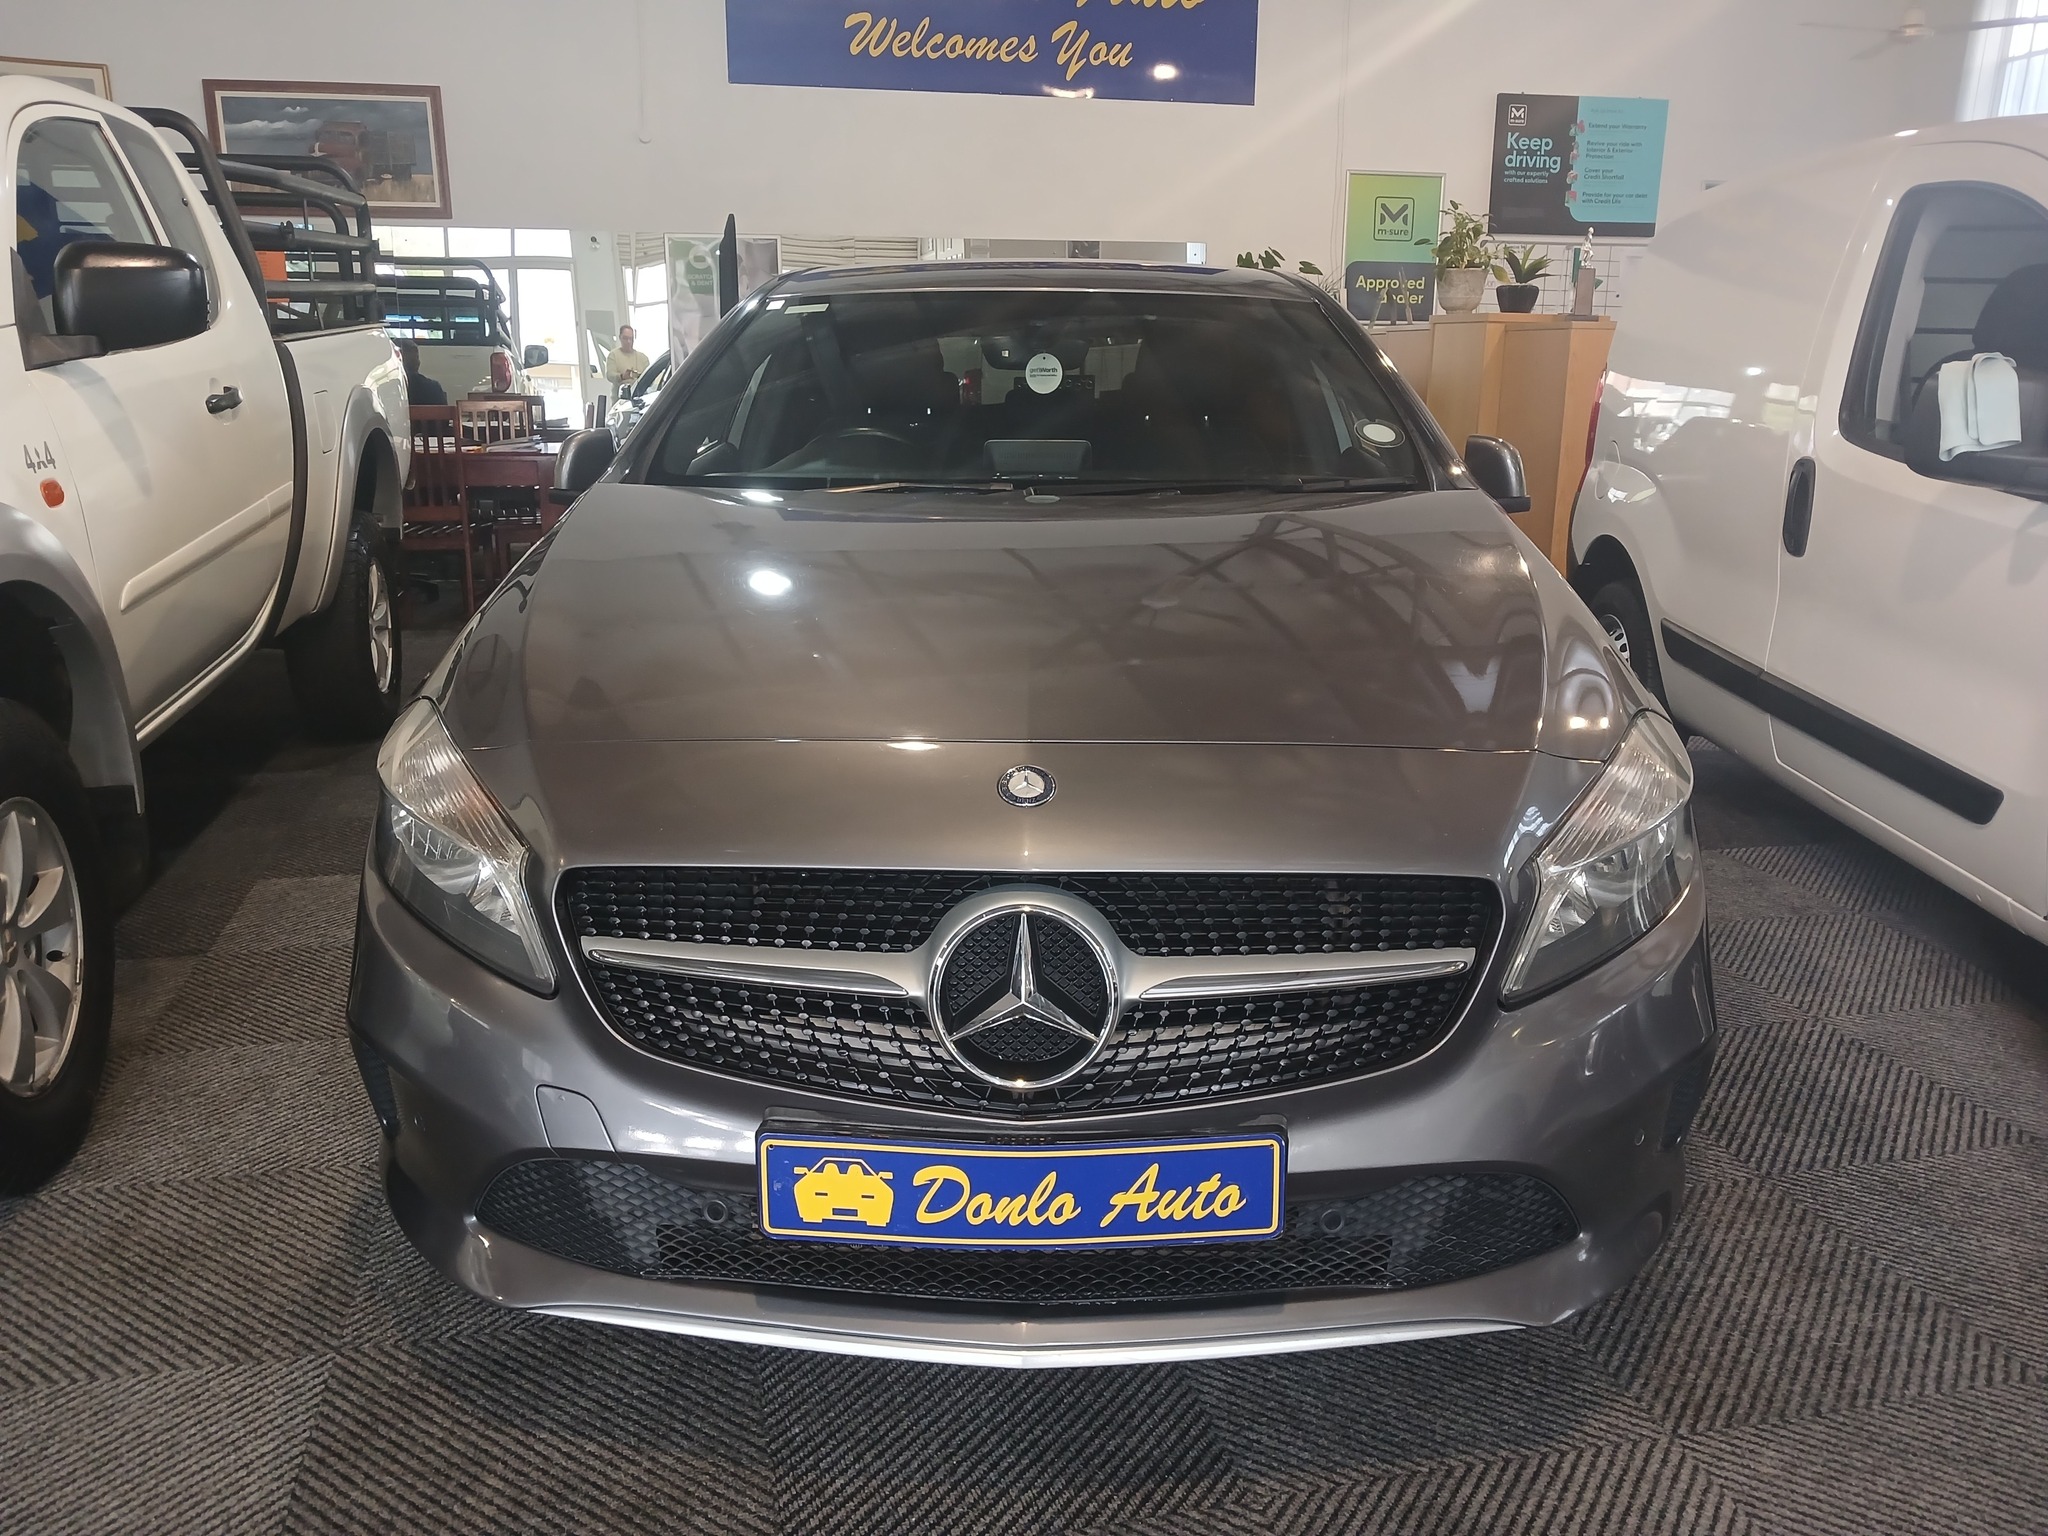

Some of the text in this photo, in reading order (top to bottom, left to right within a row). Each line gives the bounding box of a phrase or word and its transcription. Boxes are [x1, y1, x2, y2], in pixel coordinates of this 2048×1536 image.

[844, 12, 1133, 81] Welcomes You
[1507, 132, 1553, 155] Keep
[1504, 150, 1561, 173] driving
[1526, 170, 1549, 178] expertly
[1377, 228, 1409, 236] m-sure
[1355, 274, 1425, 292] Approed
[912, 1163, 1248, 1229] Donlo Auto
